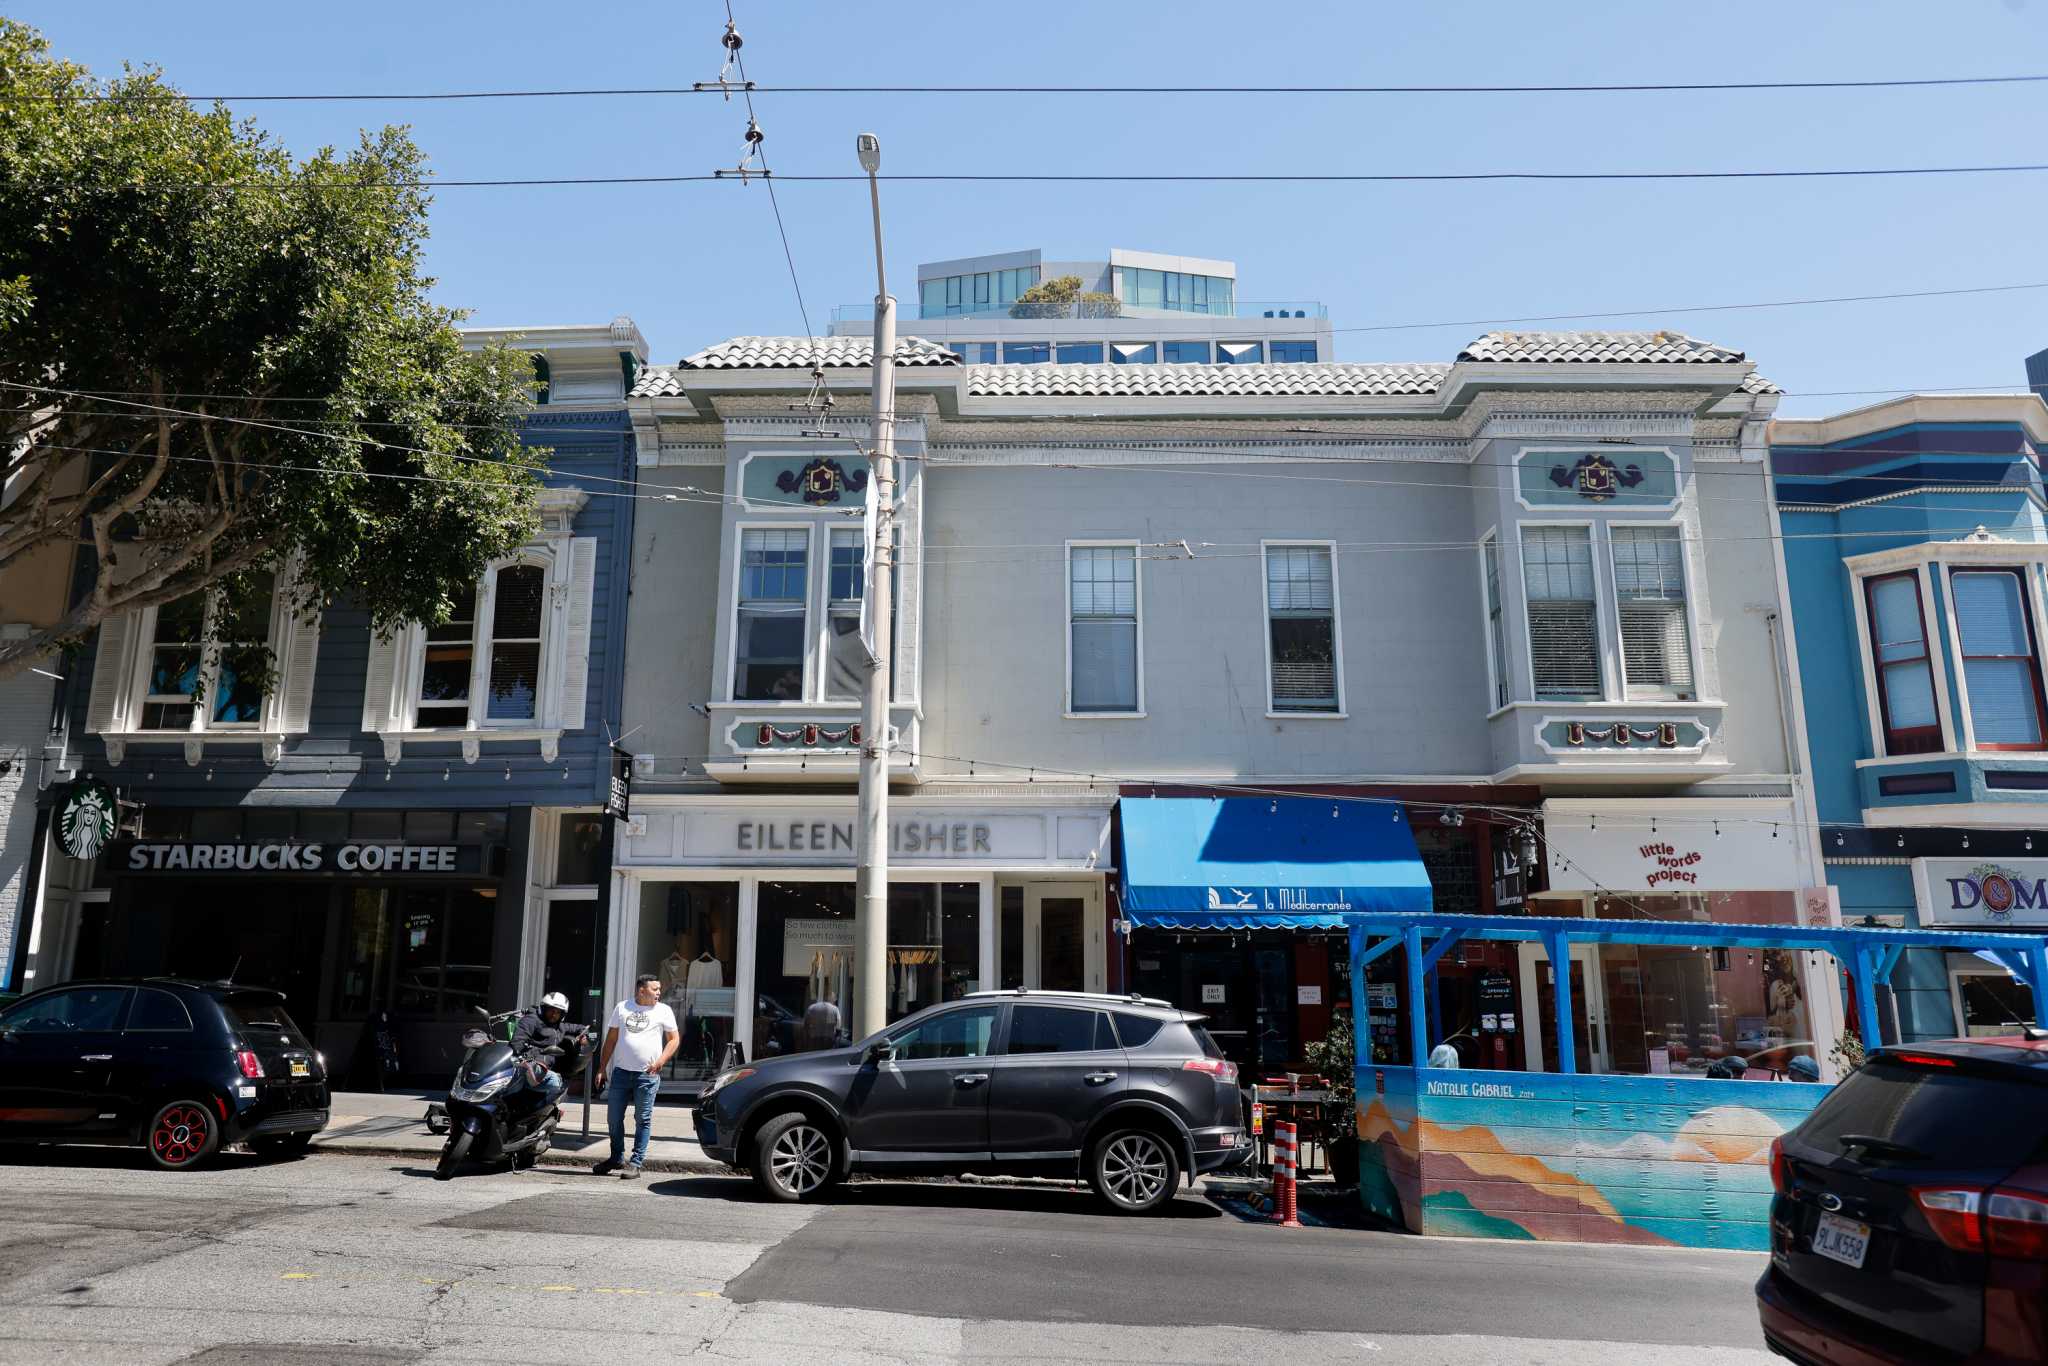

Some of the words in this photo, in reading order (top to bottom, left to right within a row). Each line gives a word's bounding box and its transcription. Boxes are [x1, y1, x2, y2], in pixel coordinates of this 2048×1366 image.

[737, 823, 853, 850] EILEEN
[887, 824, 992, 852] ISHER
[129, 845, 322, 869] STARBUCKS
[337, 846, 456, 870] COFFEE
[1640, 843, 1674, 858] little
[1658, 852, 1702, 868] words
[1646, 867, 1697, 887] project
[1264, 888, 1275, 909] la
[1427, 1081, 1469, 1096] NATALIE
[1472, 1082, 1514, 1098] GABRIEL
